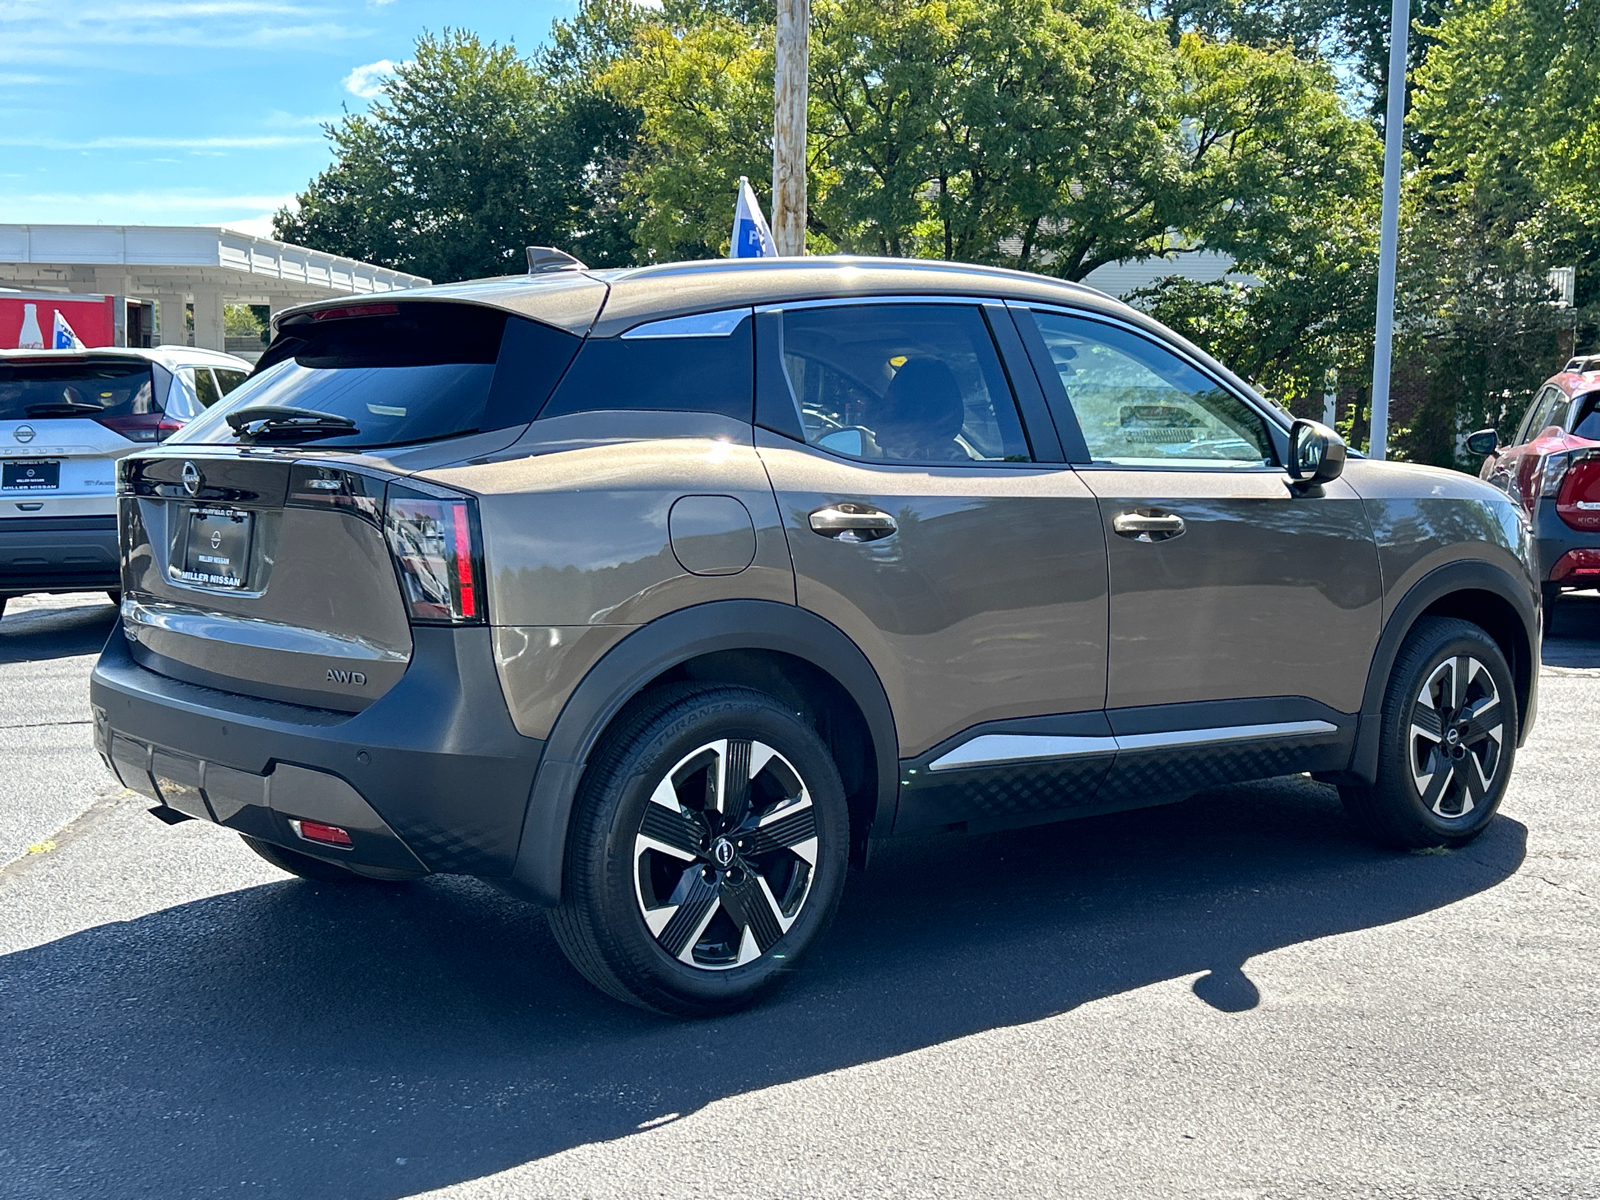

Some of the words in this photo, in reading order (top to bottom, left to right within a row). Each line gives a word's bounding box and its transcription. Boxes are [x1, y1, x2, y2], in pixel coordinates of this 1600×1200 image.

[198, 555, 213, 563] MILLER
[213, 556, 230, 565] NISSAN
[182, 571, 209, 582] MILLER
[210, 574, 240, 586] NISSAN
[326, 668, 368, 686] AWD
[654, 702, 734, 747] TURANZA
